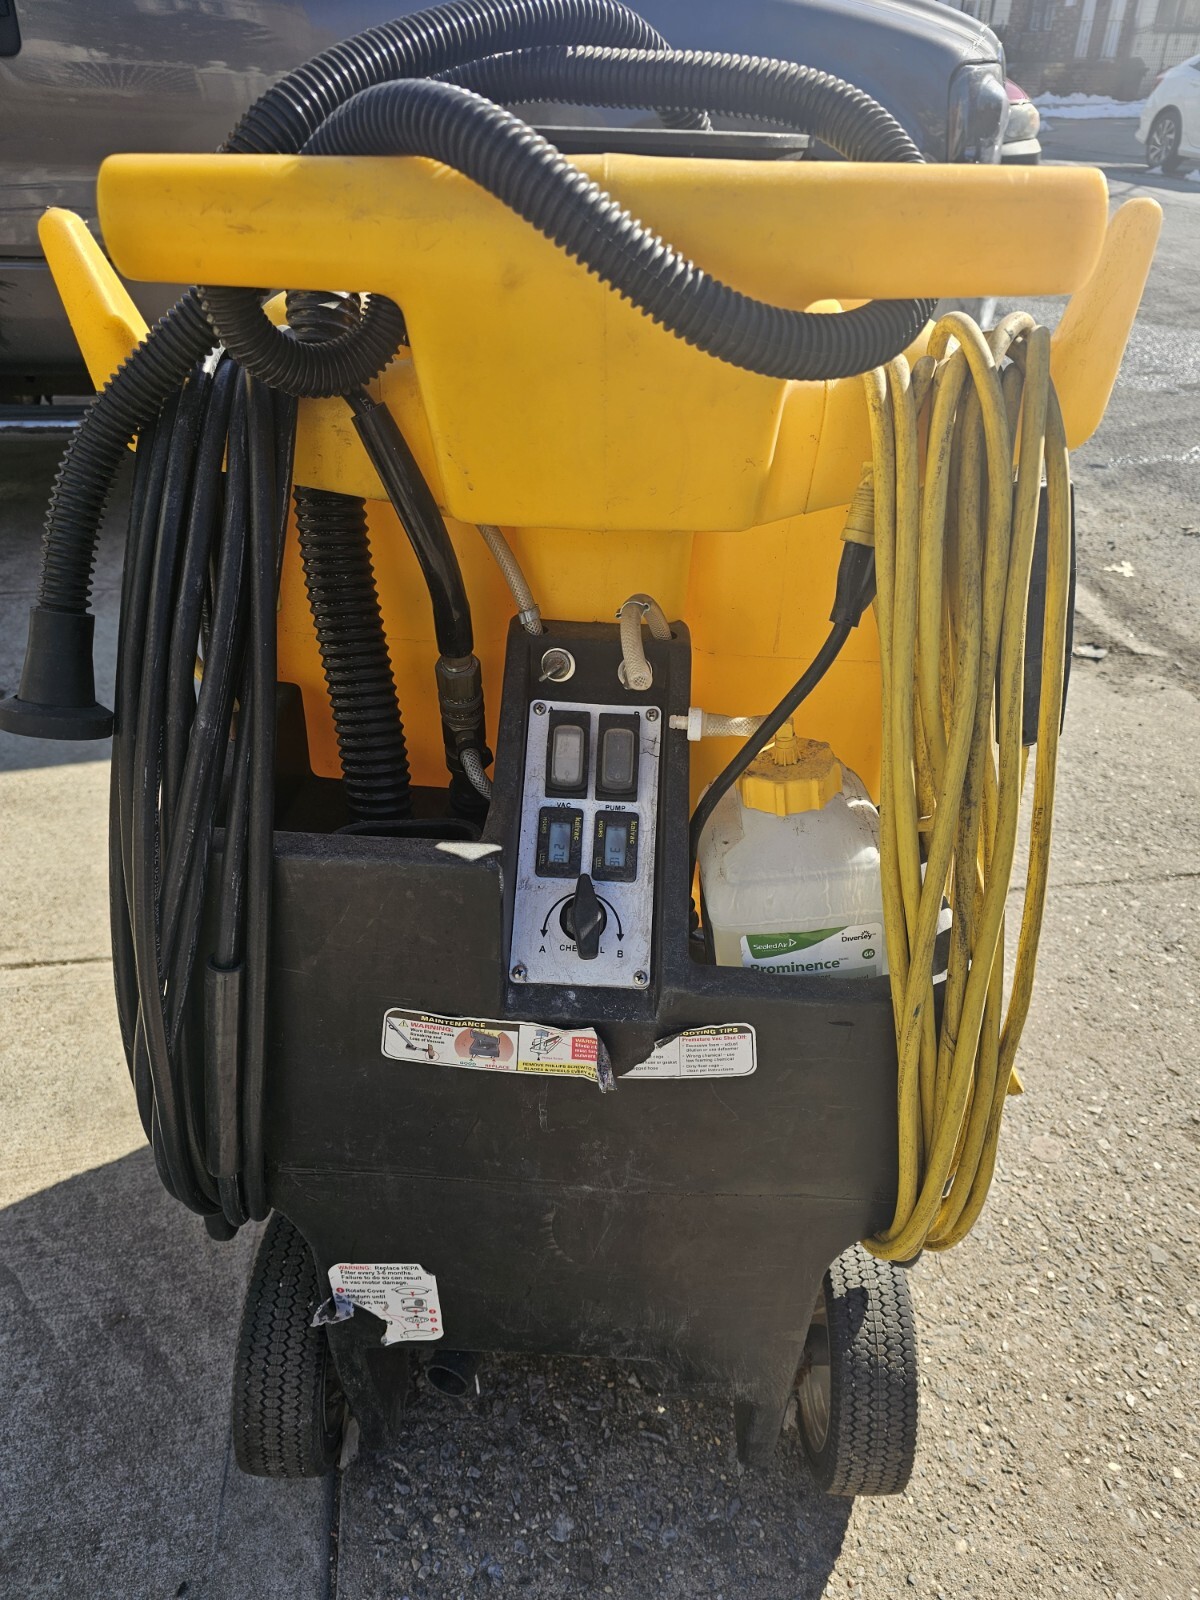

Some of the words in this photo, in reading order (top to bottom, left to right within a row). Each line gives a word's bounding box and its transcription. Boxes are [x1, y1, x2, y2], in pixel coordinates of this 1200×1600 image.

[629, 821, 637, 844] kaivac
[841, 933, 872, 942] Diversey
[539, 945, 546, 953] A
[617, 950, 623, 958] B
[420, 1015, 486, 1028] MAINTENANCE
[410, 1022, 453, 1033] WARNING:
